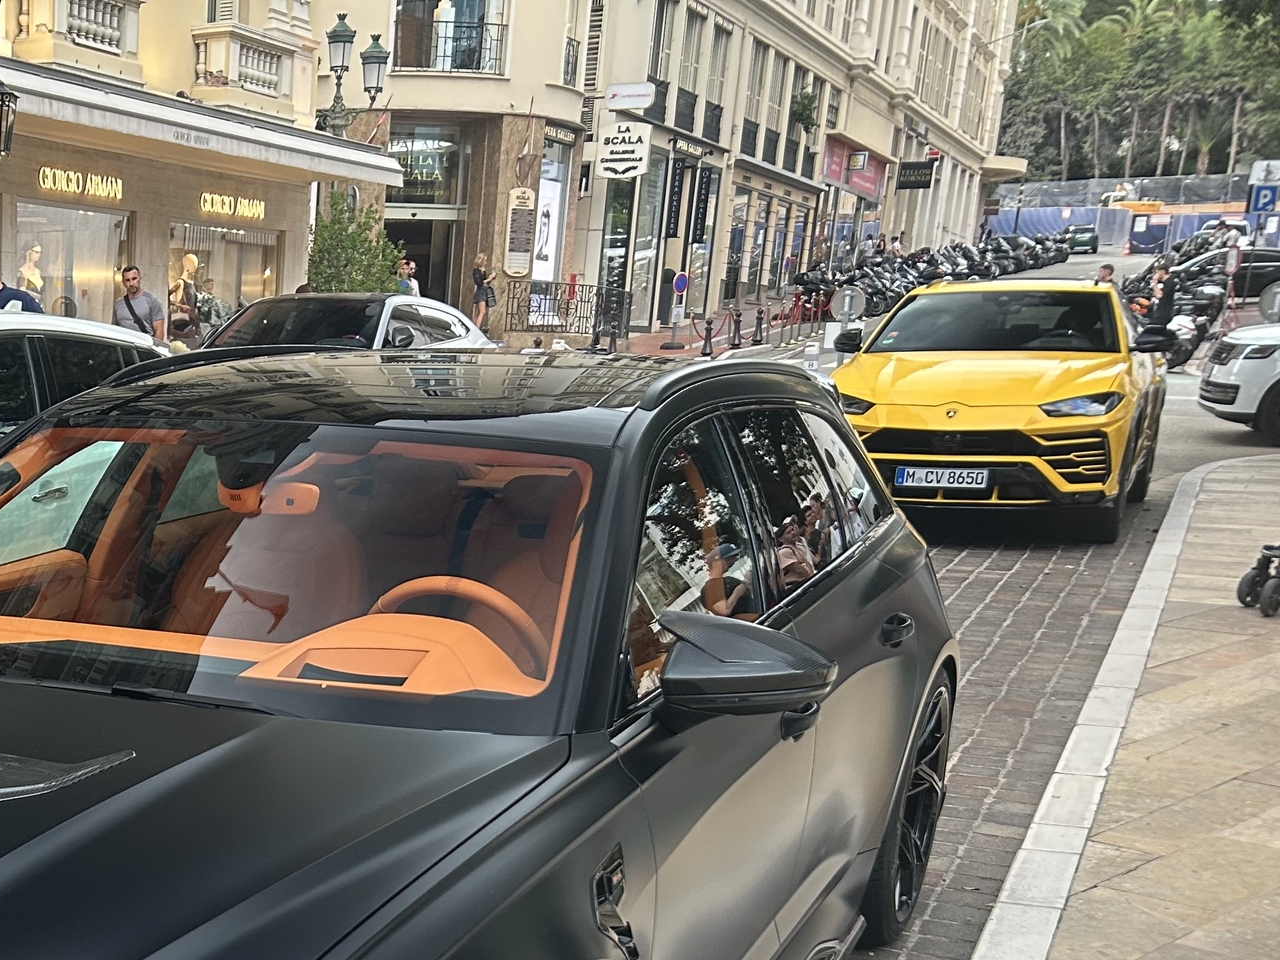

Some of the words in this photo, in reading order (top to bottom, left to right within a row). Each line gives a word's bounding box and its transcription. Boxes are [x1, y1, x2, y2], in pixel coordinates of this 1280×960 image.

[544, 125, 556, 137] PERA
[617, 125, 631, 133] LA
[603, 136, 643, 145] SCALA
[419, 155, 433, 165] LA
[402, 167, 443, 181] CALA
[39, 166, 83, 193] GIORGIO
[84, 172, 123, 200] ARMANI
[200, 192, 235, 215] GIORGIO
[234, 196, 265, 219] ARMANI
[1257, 189, 1272, 208] P
[905, 470, 916, 483] M
[924, 470, 945, 484] CV
[947, 470, 985, 485] 8650
